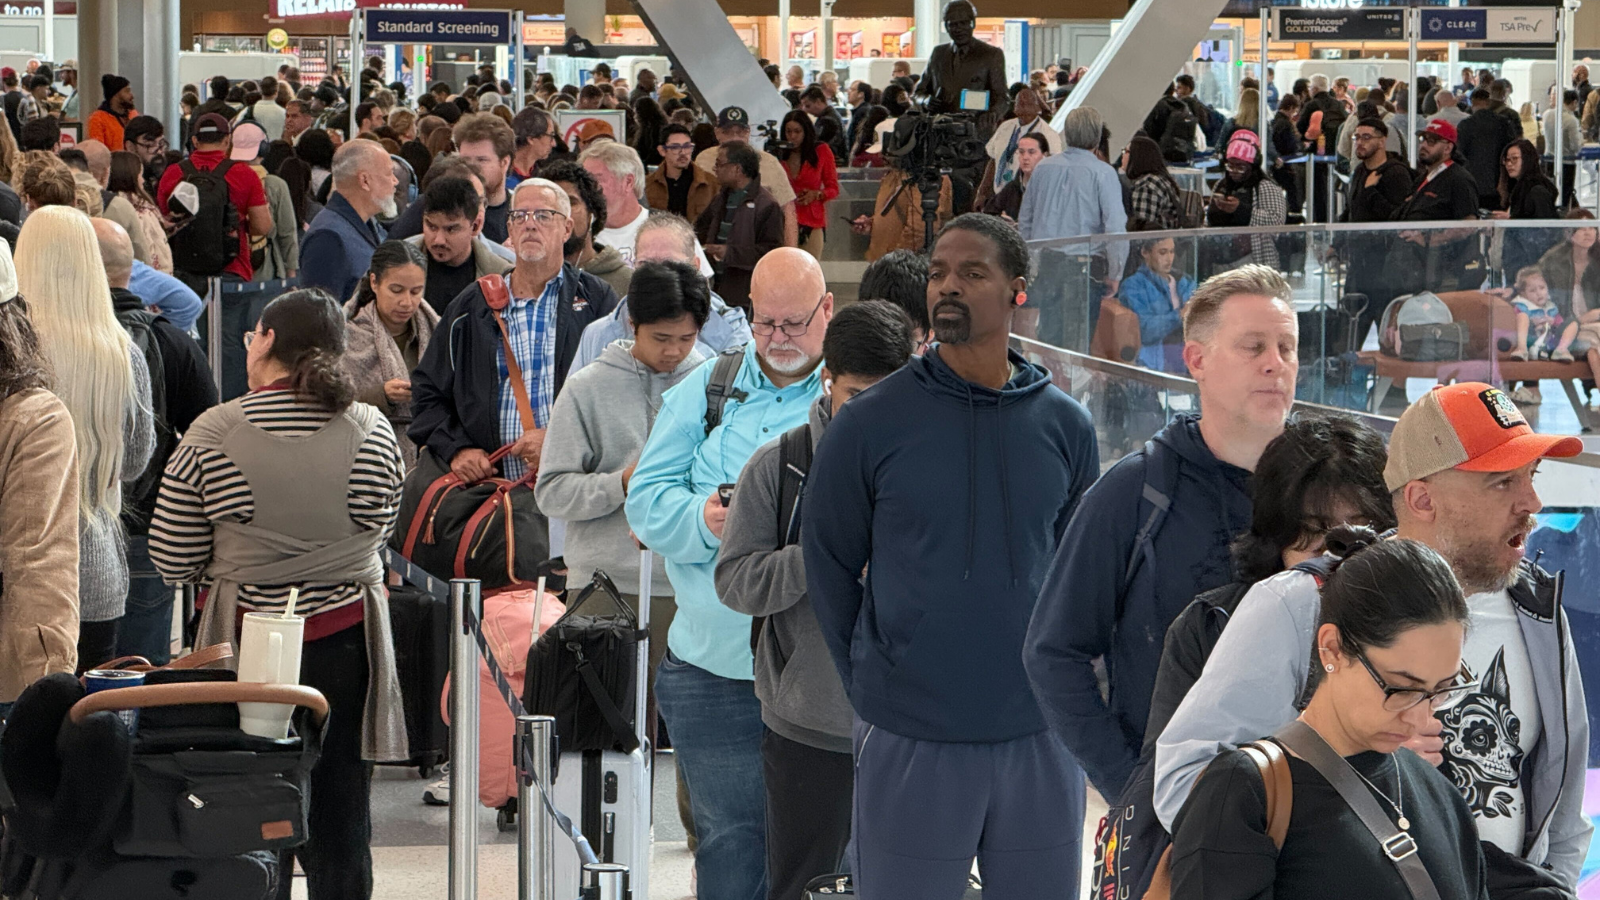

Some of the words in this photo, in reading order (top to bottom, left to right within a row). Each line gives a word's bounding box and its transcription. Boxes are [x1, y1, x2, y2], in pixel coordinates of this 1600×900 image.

[4, 4, 20, 16] to
[377, 21, 433, 33] Standard
[437, 21, 499, 37] Screening
[1285, 25, 1339, 33] GOLDTRACK
[1500, 22, 1515, 31] TSA
